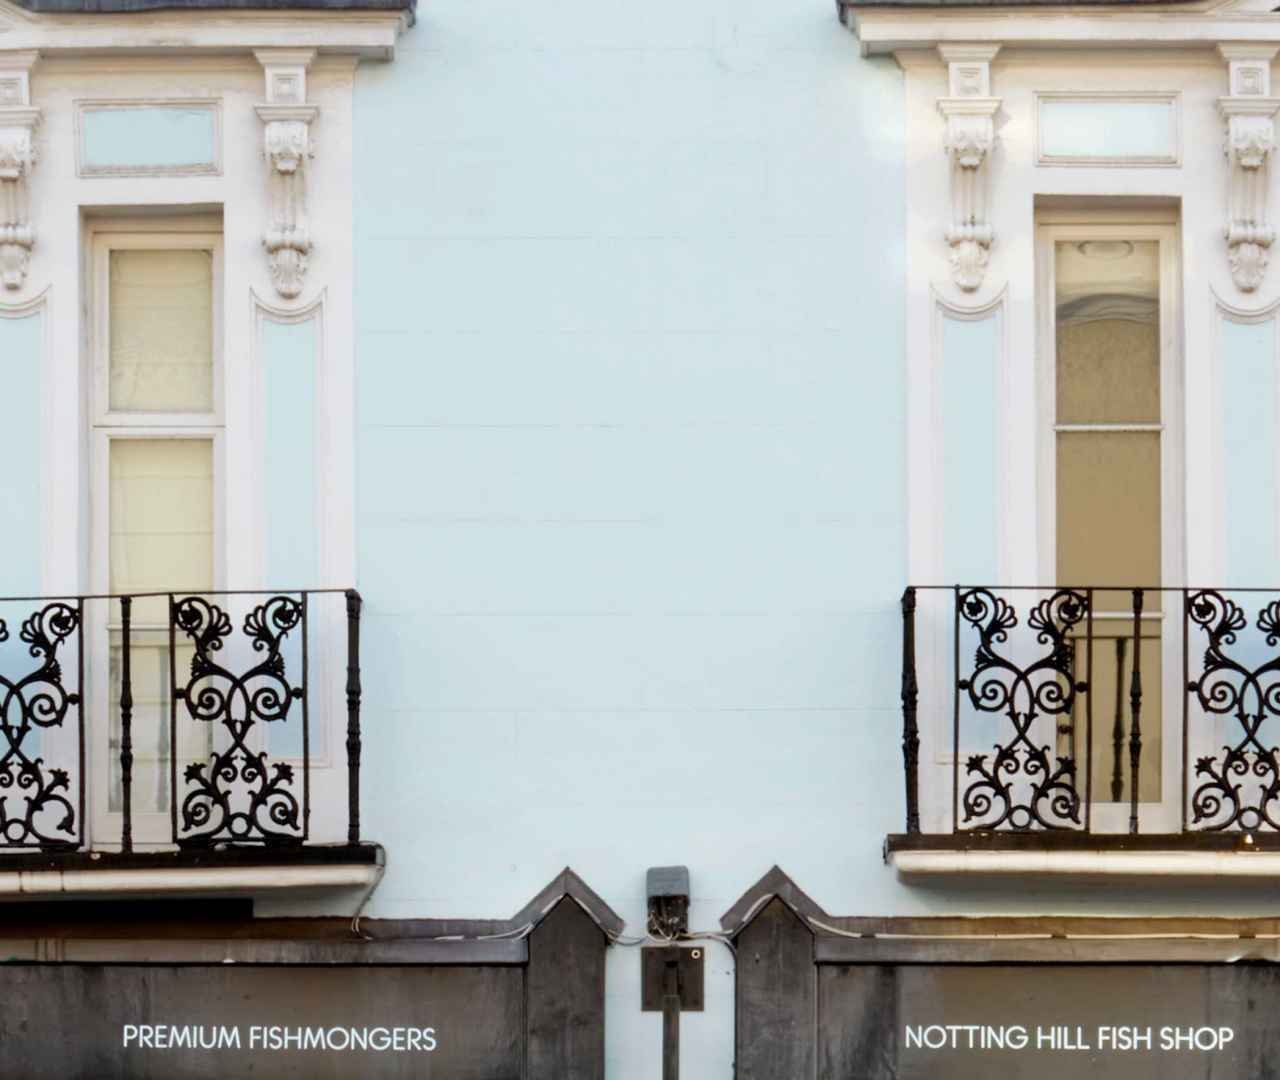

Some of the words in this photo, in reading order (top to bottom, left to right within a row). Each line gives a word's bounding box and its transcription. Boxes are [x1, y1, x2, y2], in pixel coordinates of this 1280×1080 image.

[122, 1024, 242, 1050] PREMIUM
[249, 1025, 438, 1052] FISHMONGERS
[905, 1024, 1030, 1050] NOTTING
[1036, 1025, 1091, 1050] HILL
[1097, 1025, 1152, 1051] FISH
[1159, 1025, 1235, 1051] SHOP
